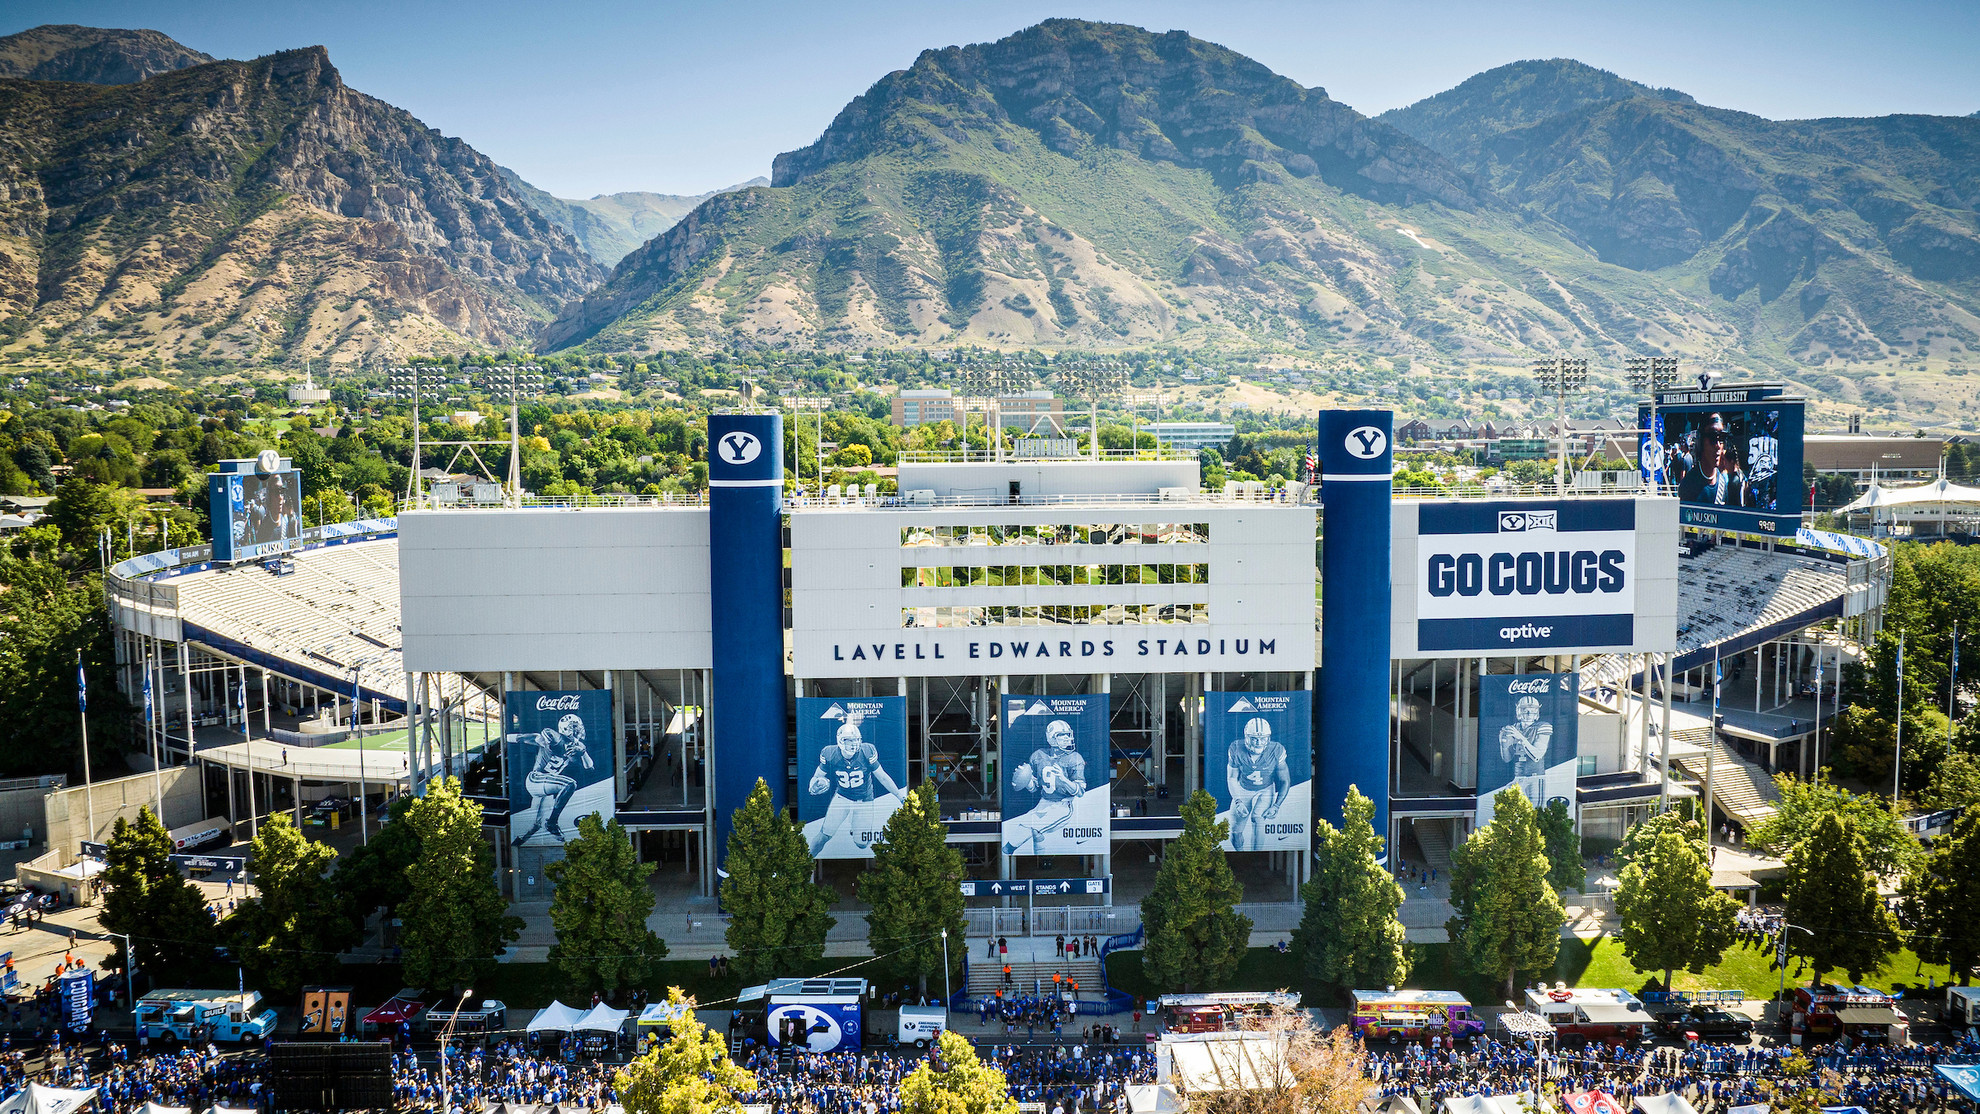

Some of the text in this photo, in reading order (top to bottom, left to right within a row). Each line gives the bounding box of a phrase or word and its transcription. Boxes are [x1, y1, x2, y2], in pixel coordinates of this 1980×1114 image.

[1663, 391, 1748, 404] BRIGHAM YOUNG UNIVERSITY
[724, 435, 754, 461] Y
[1352, 431, 1387, 456] Y
[1505, 514, 1522, 528] Y
[1693, 511, 1717, 524] NU SKIN
[1428, 550, 1626, 597] GO COUGS
[1500, 622, 1551, 642] aptive
[834, 638, 1276, 661] LAVELL EDWARDS STADIUM
[1508, 678, 1551, 694] Coca-Cola
[536, 695, 581, 711] Coca-Cola
[835, 770, 864, 788] 32
[1042, 766, 1056, 794] 9
[1246, 771, 1264, 786] 4
[861, 832, 872, 842] GO
[1062, 827, 1103, 838] GO COUGS
[1264, 824, 1303, 834] GO COUGS
[70, 980, 88, 1021] COUGAR
[204, 1007, 226, 1018] BUILT
